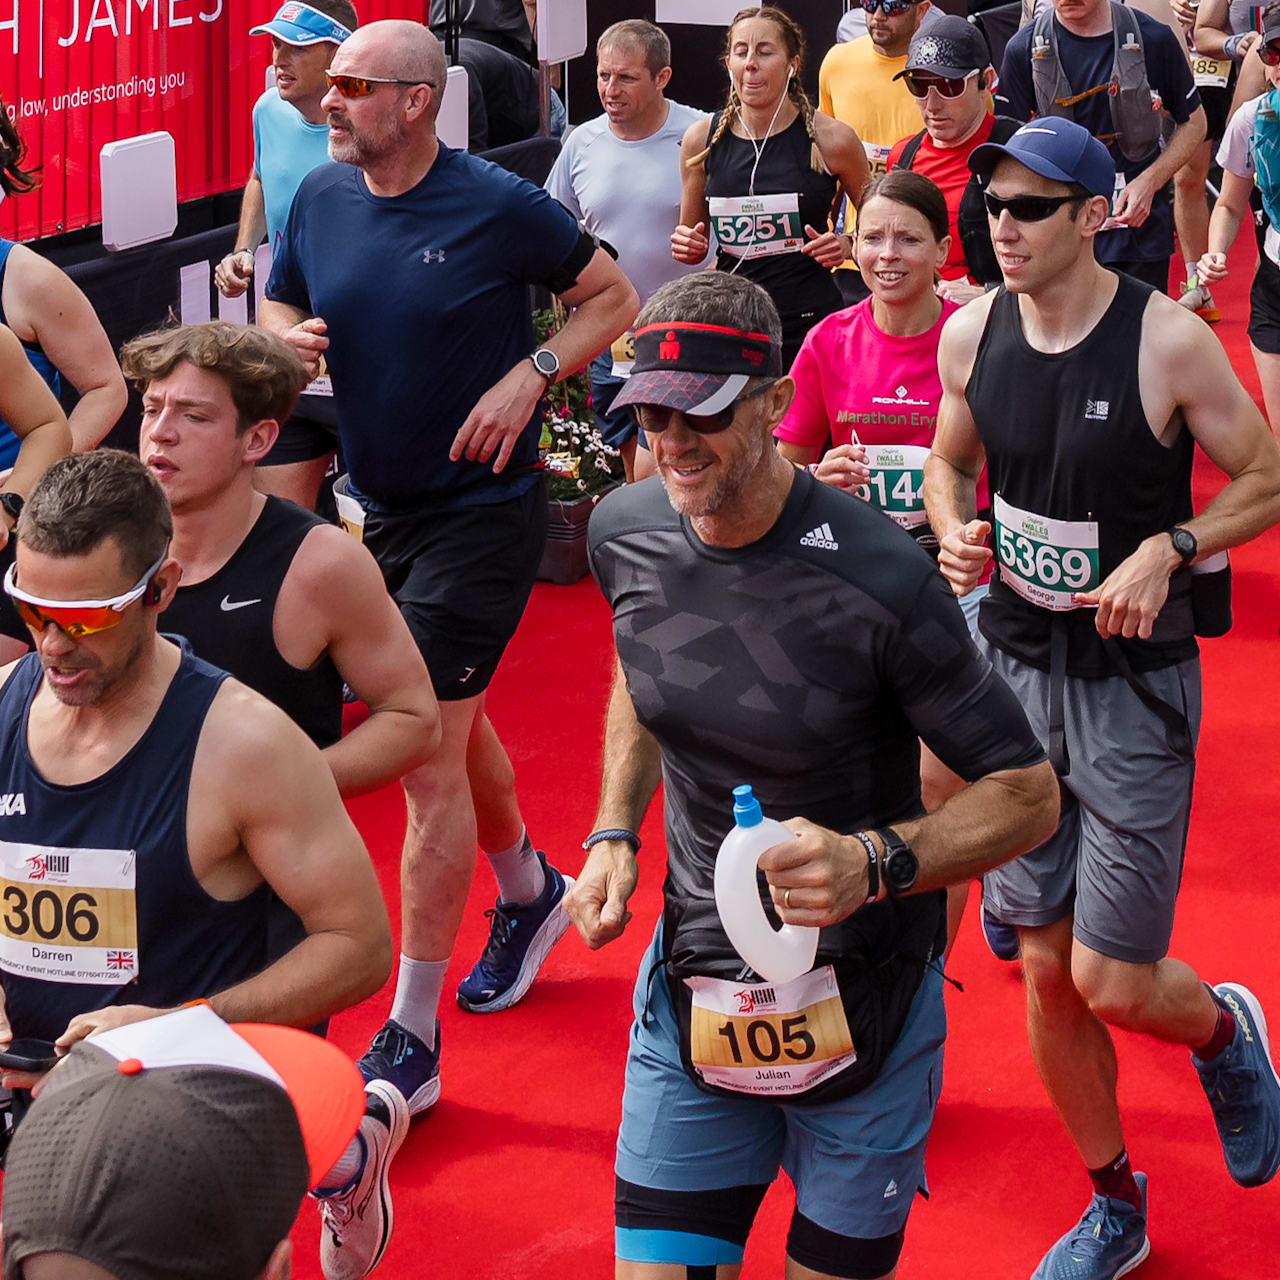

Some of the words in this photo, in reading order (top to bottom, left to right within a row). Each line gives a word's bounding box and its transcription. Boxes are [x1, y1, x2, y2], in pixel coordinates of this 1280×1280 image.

[50, 77, 153, 114] understanding
[157, 71, 186, 99] you
[717, 213, 793, 244] 5251
[836, 410, 907, 426] Marathon
[800, 535, 839, 551] adidas
[999, 523, 1092, 589] 5369
[1026, 583, 1057, 603] George
[3, 885, 100, 942] 306
[31, 946, 74, 962] Darren
[718, 1014, 817, 1064] 105
[755, 1070, 792, 1081] Julian
